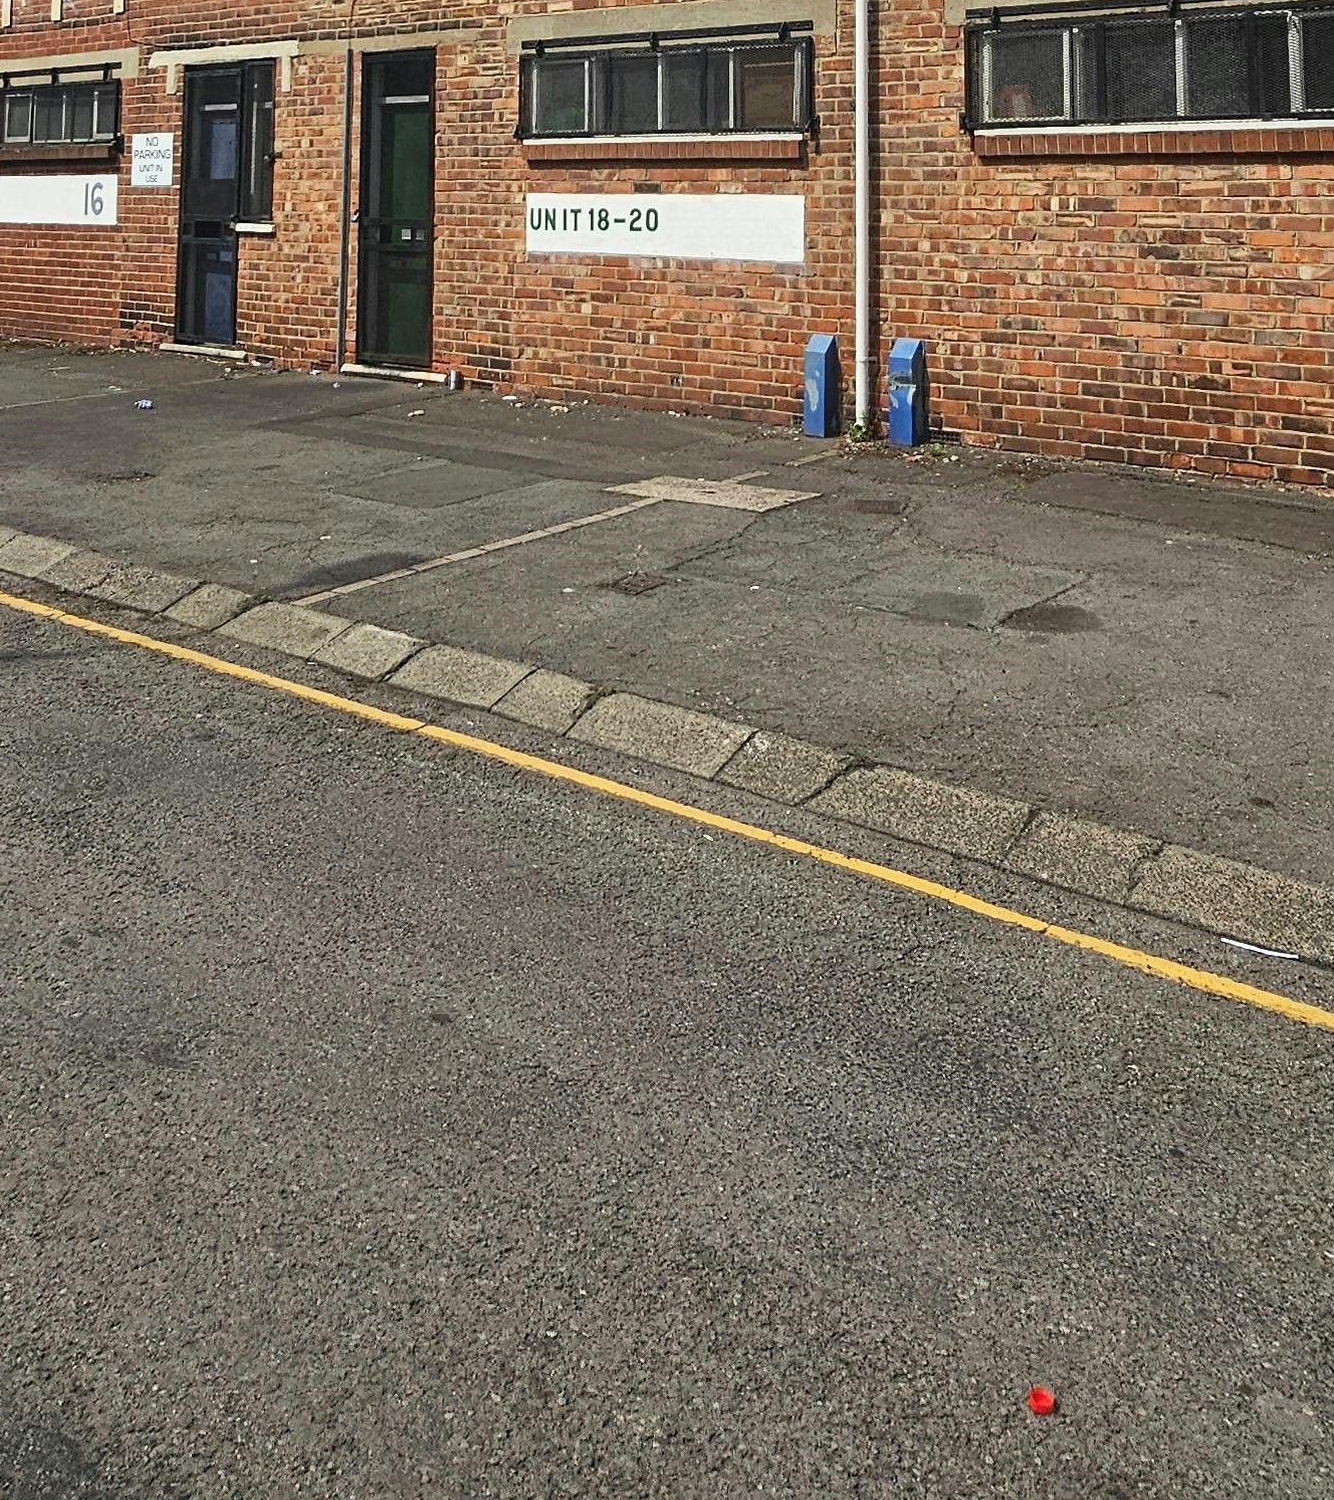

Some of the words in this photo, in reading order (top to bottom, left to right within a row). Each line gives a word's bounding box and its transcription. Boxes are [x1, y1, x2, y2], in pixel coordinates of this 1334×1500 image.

[146, 136, 159, 146] NO
[133, 149, 171, 159] PARKING
[139, 164, 154, 172] UNIT
[155, 164, 163, 172] IN
[145, 174, 158, 182] USE
[84, 182, 104, 216] 16
[530, 207, 582, 231] UNIT
[588, 207, 659, 232] 18-20
